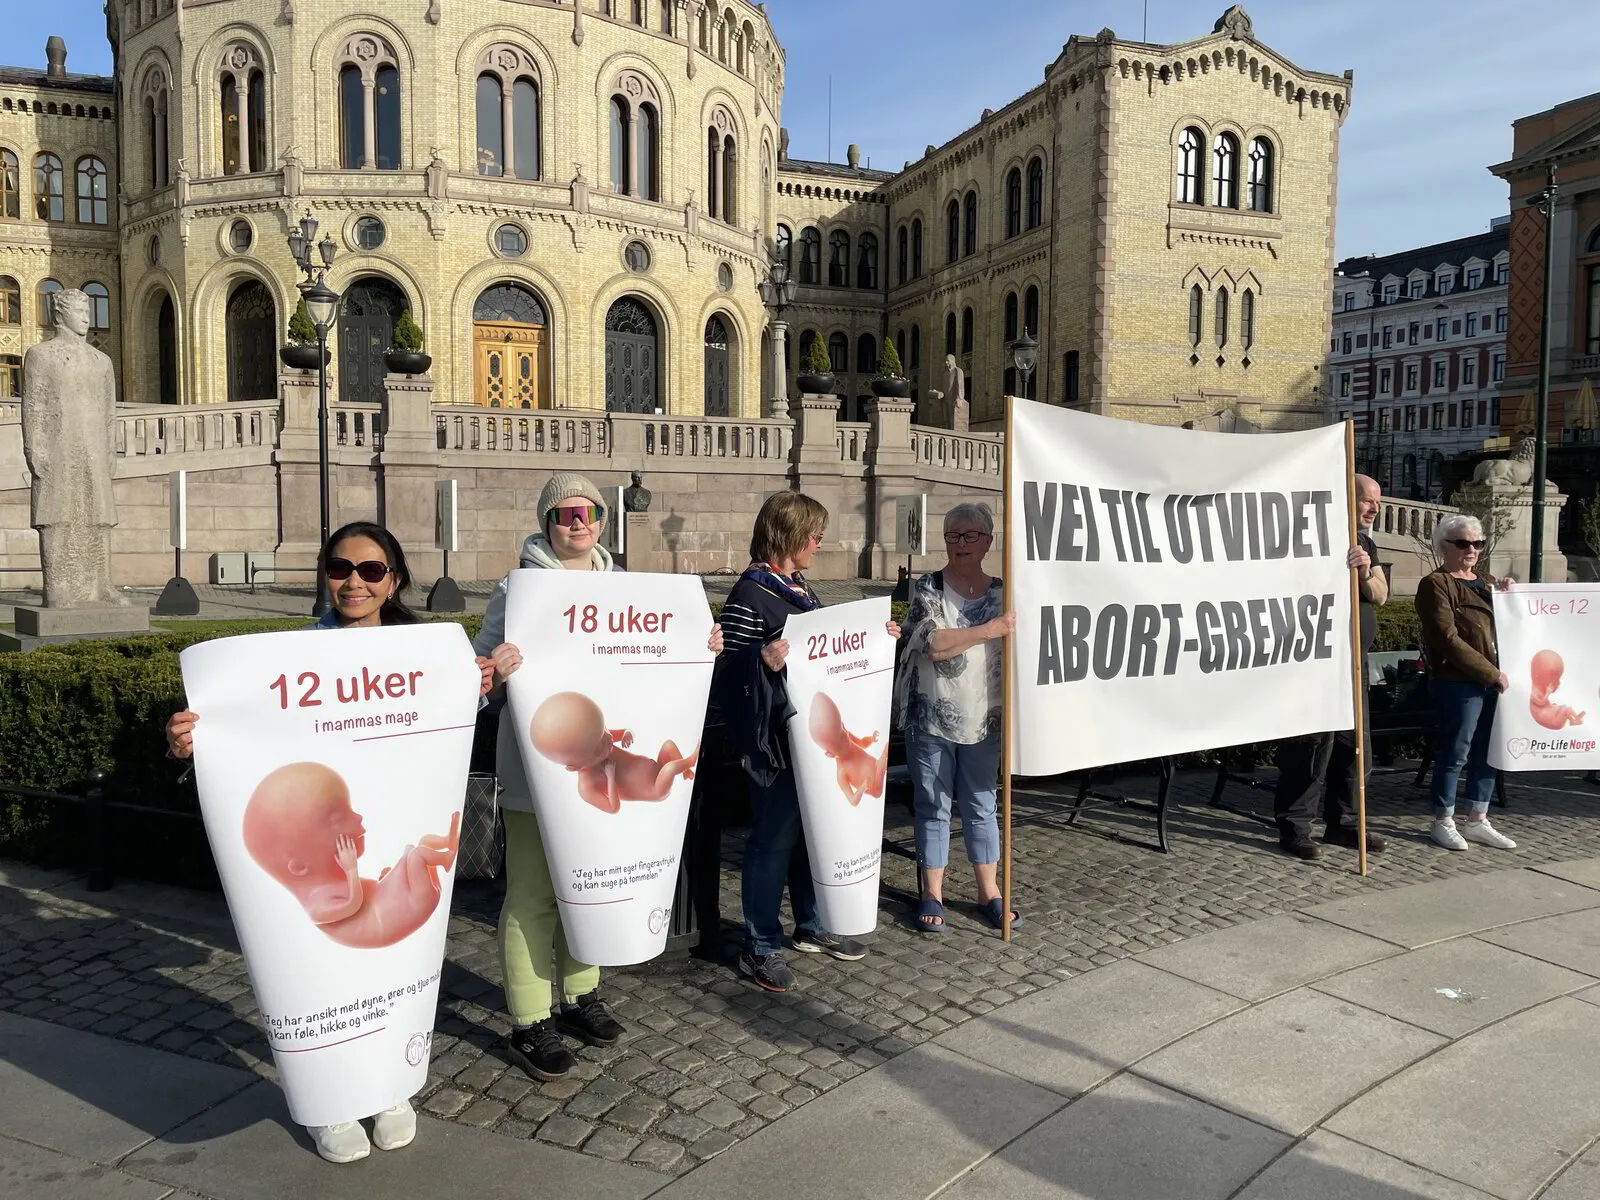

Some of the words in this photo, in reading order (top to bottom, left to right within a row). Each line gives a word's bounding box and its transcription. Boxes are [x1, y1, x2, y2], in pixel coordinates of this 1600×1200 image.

[1023, 481, 1100, 562] NEI
[1099, 488, 1163, 563] TIL
[1163, 490, 1333, 564] UTVIDET
[1528, 599, 1560, 615] Uke
[1569, 599, 1589, 615] 12
[563, 604, 598, 634] 18
[608, 605, 673, 633] uker
[592, 644, 596, 655] i
[597, 645, 641, 655] mammas
[643, 645, 667, 657] mage
[807, 633, 828, 660] 22
[832, 629, 867, 655] uker
[1037, 593, 1335, 686] ABORT-GRENSE
[830, 663, 854, 675] mammas
[854, 659, 869, 670] mage
[270, 671, 322, 710] 12
[336, 667, 423, 704] uker
[315, 719, 319, 733] i
[322, 715, 382, 733] mammas
[385, 710, 419, 727] mage
[1530, 739, 1568, 750] Pro-Life
[1569, 739, 1596, 752] Norge
[594, 868, 606, 877] har
[608, 866, 622, 875] mitt
[623, 862, 637, 875] eget
[834, 872, 842, 880] og
[844, 869, 853, 877] har
[572, 882, 582, 891] og
[584, 880, 599, 890] kan
[600, 880, 618, 890] suge
[619, 876, 628, 888] på
[284, 1015, 302, 1026] har
[306, 1006, 338, 1023] ansikt
[340, 999, 359, 1015] med
[361, 995, 386, 1010] øyne,
[388, 987, 404, 1000] ører
[406, 983, 416, 994] og
[274, 1028, 292, 1040] kan
[295, 1026, 318, 1040] føle,
[320, 1019, 347, 1034] hikke
[349, 1016, 361, 1028] og
